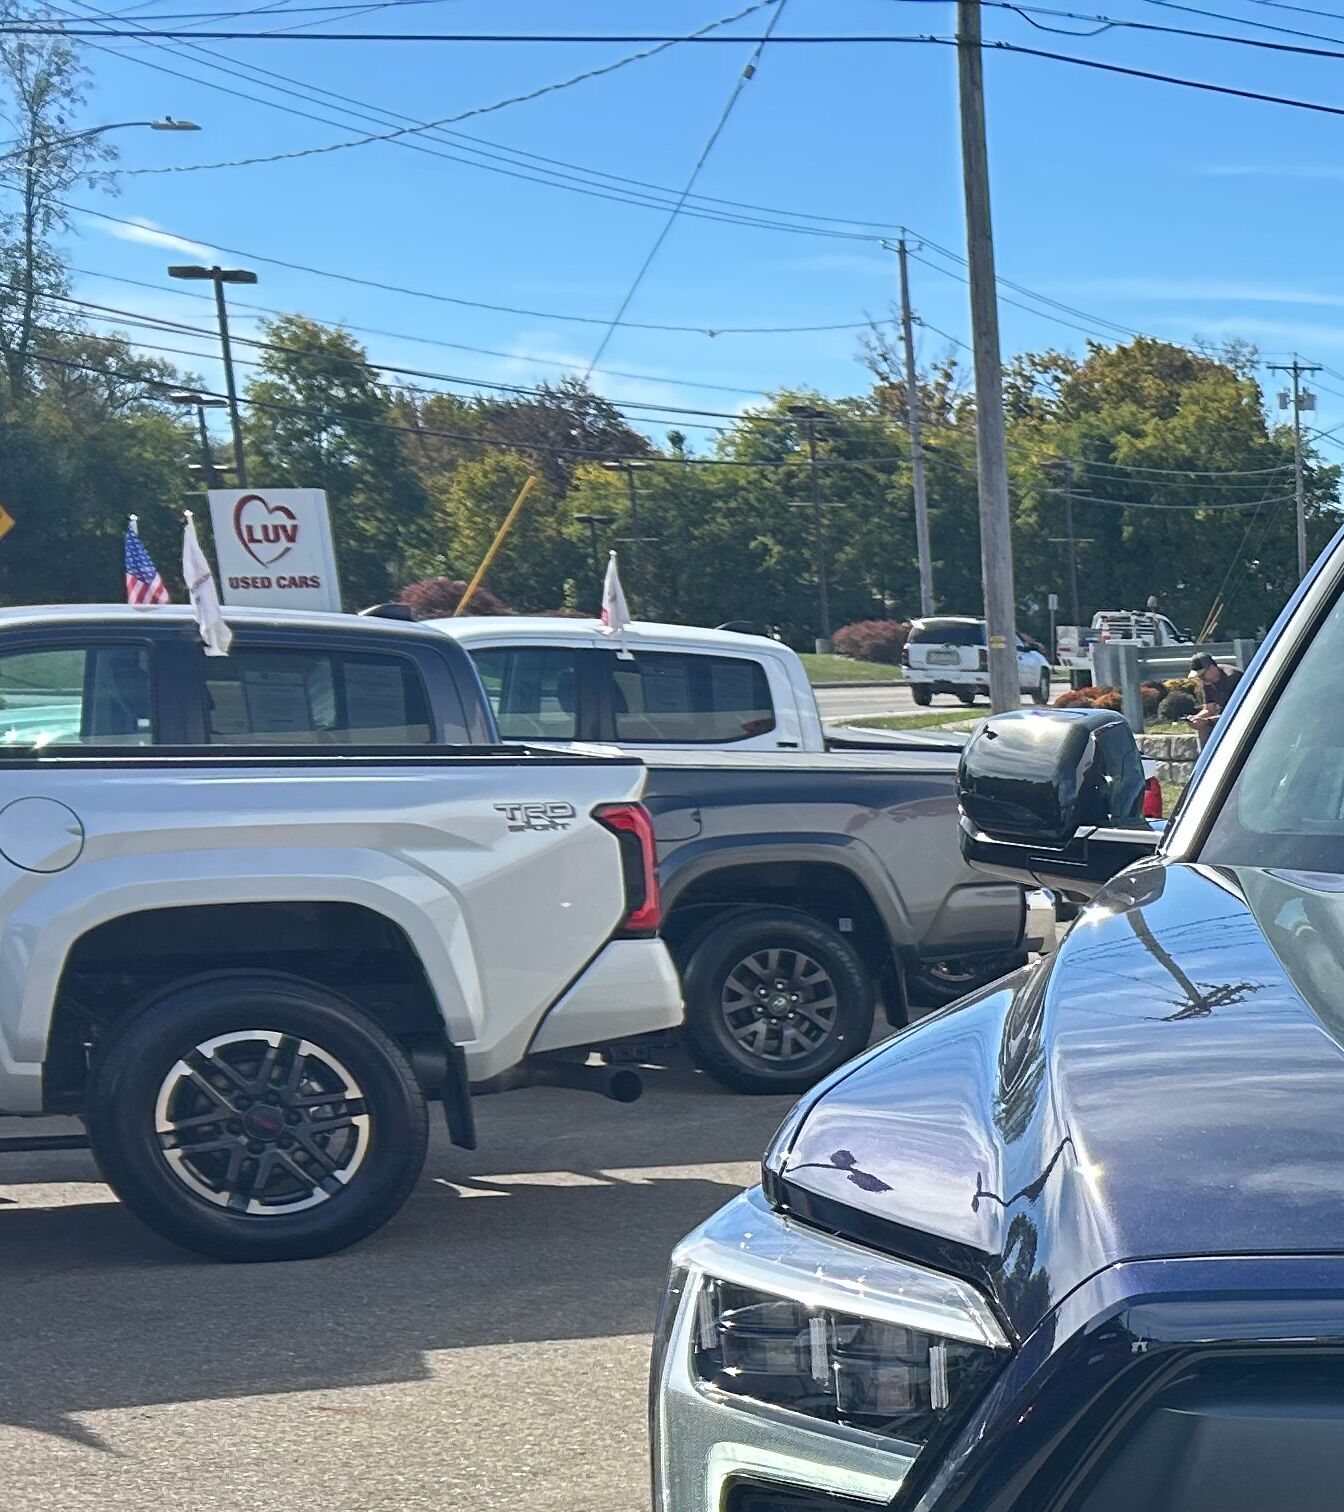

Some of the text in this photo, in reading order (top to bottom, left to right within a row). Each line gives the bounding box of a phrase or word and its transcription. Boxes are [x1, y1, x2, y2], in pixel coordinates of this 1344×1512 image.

[245, 524, 299, 544] LUV
[228, 576, 272, 590] USED
[275, 575, 321, 589] CARS
[493, 801, 577, 825] TRD
